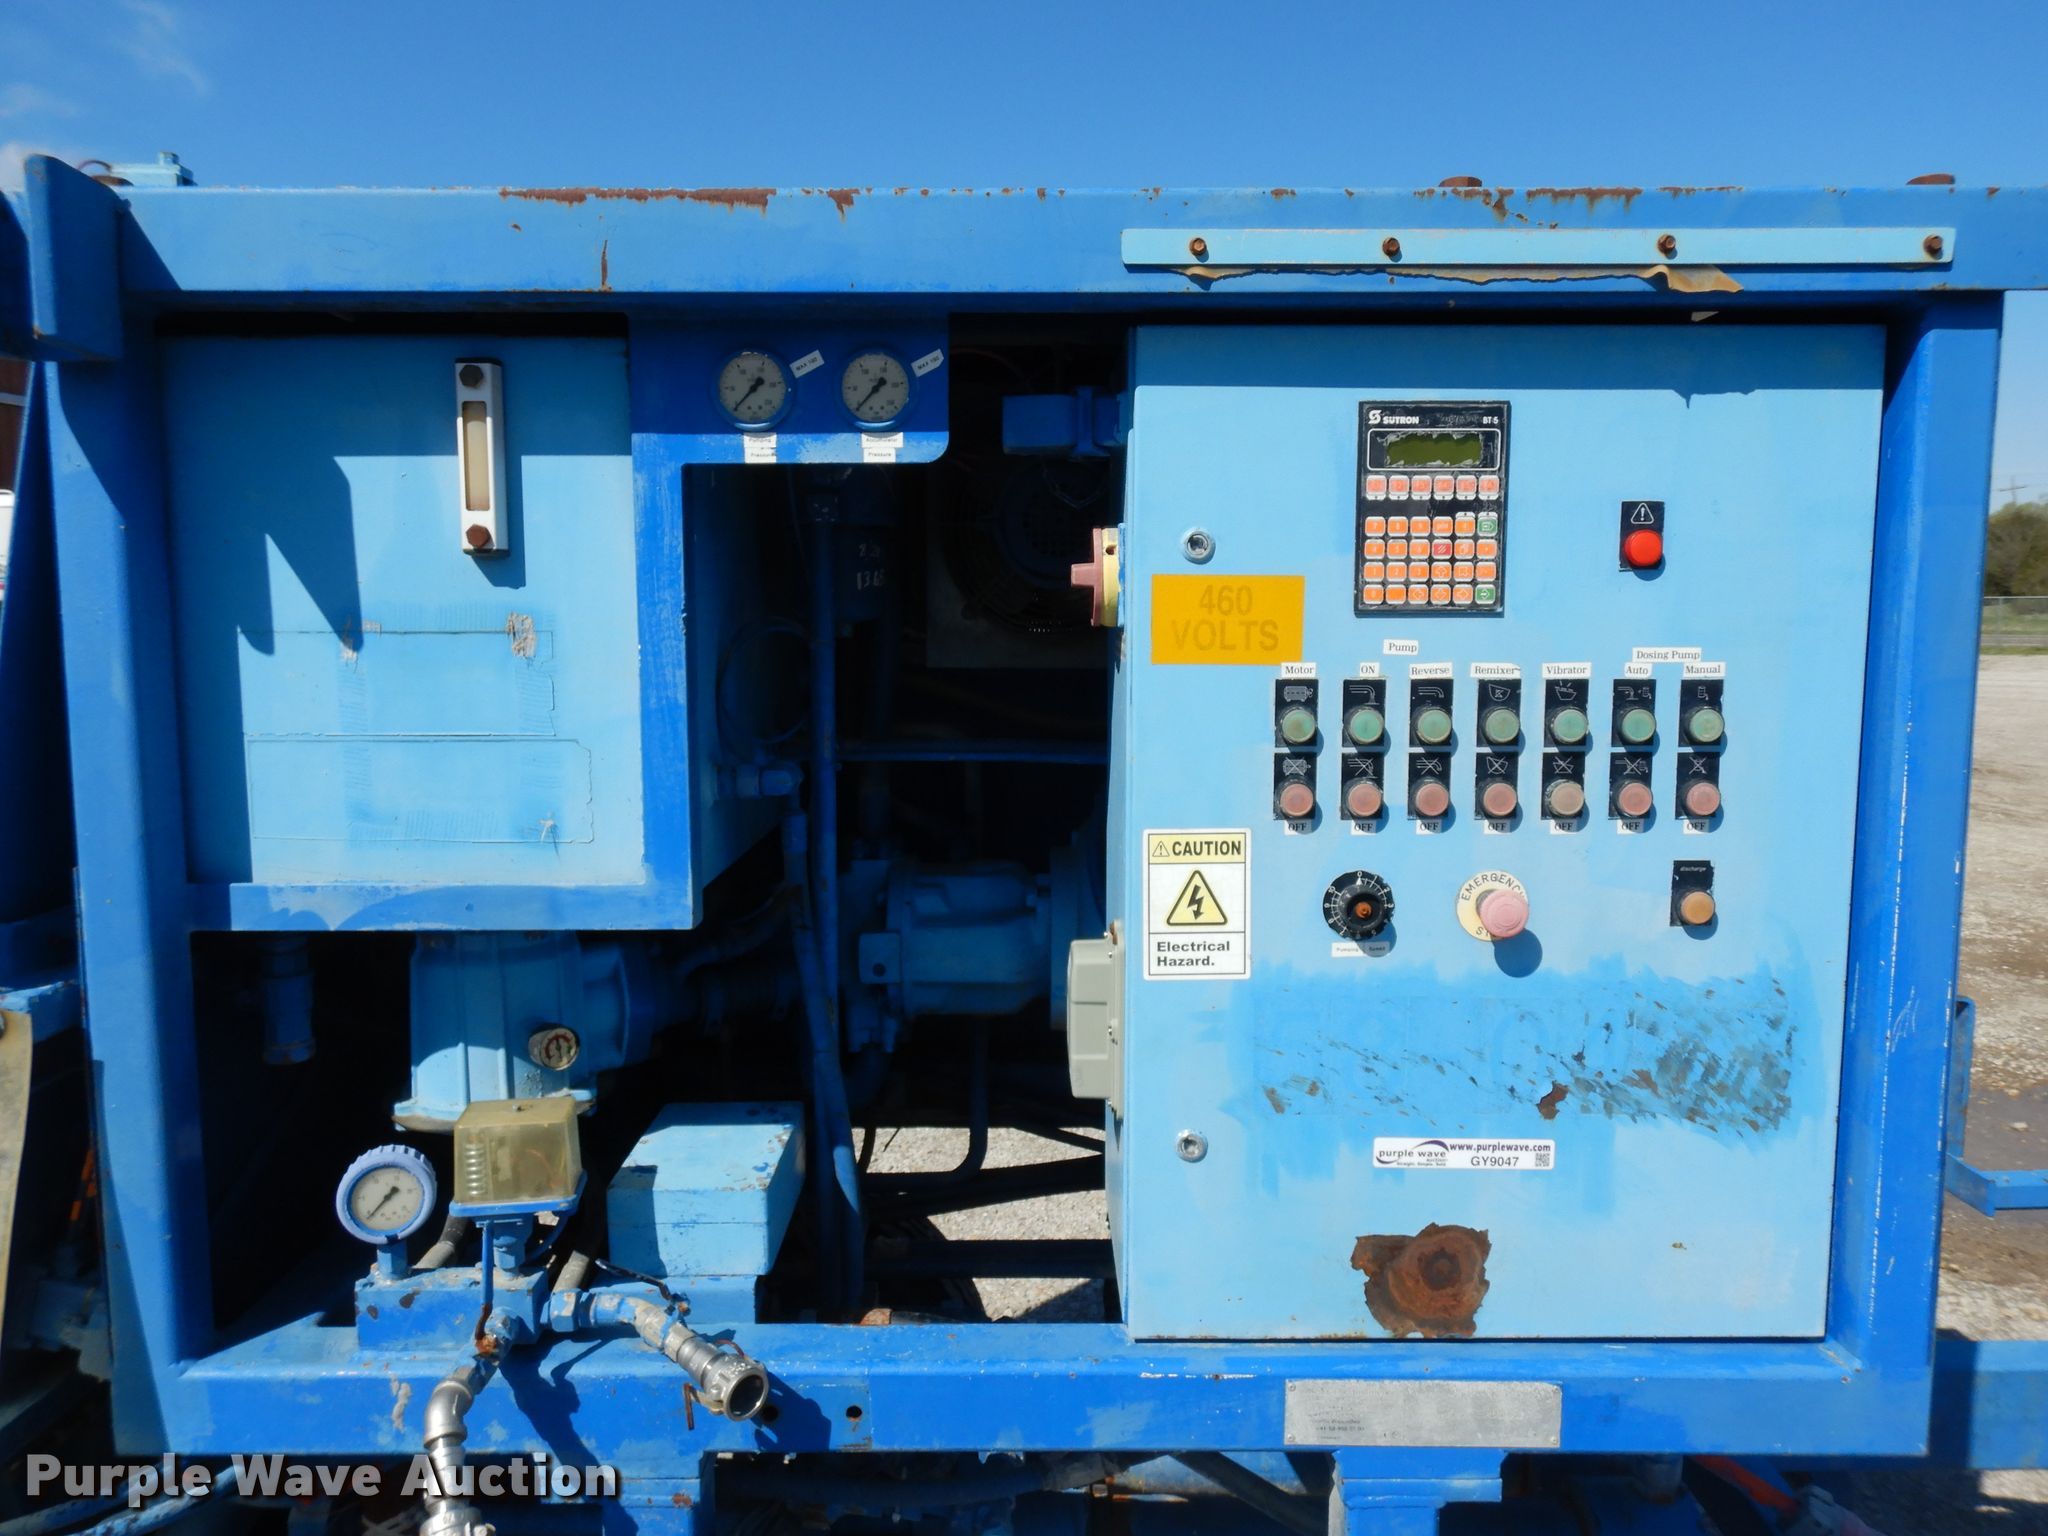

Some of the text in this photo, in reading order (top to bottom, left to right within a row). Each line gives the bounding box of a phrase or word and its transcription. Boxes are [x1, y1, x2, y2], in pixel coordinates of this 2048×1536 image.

[1383, 416, 1420, 425] SUTRON
[1199, 584, 1254, 617] 460
[1171, 619, 1280, 652] VOLTS
[1388, 641, 1418, 654] Pump
[1636, 649, 1701, 662] Dosing Pump
[1285, 665, 1315, 675] Motor
[1360, 665, 1376, 674] ON
[1411, 666, 1450, 676] Reverse
[1474, 666, 1516, 675] Remixer
[1546, 665, 1587, 675] Vibrator
[1625, 666, 1649, 675] Auto
[1685, 664, 1722, 675] Manual
[1288, 823, 1307, 832] OFF
[1354, 823, 1373, 832] OFF
[1419, 823, 1439, 831] OFF
[1487, 822, 1507, 831] OFF
[1554, 822, 1574, 831] OFF
[1621, 821, 1641, 831] OFF
[1686, 821, 1706, 831] OFF
[1171, 840, 1242, 857] CAUTION
[1157, 940, 1231, 953] Electrical
[1157, 955, 1216, 967] Hazard.
[1449, 1141, 1552, 1153] www.purplewave.com
[1379, 1149, 1414, 1160] purple
[1470, 1156, 1520, 1167] GY9047
